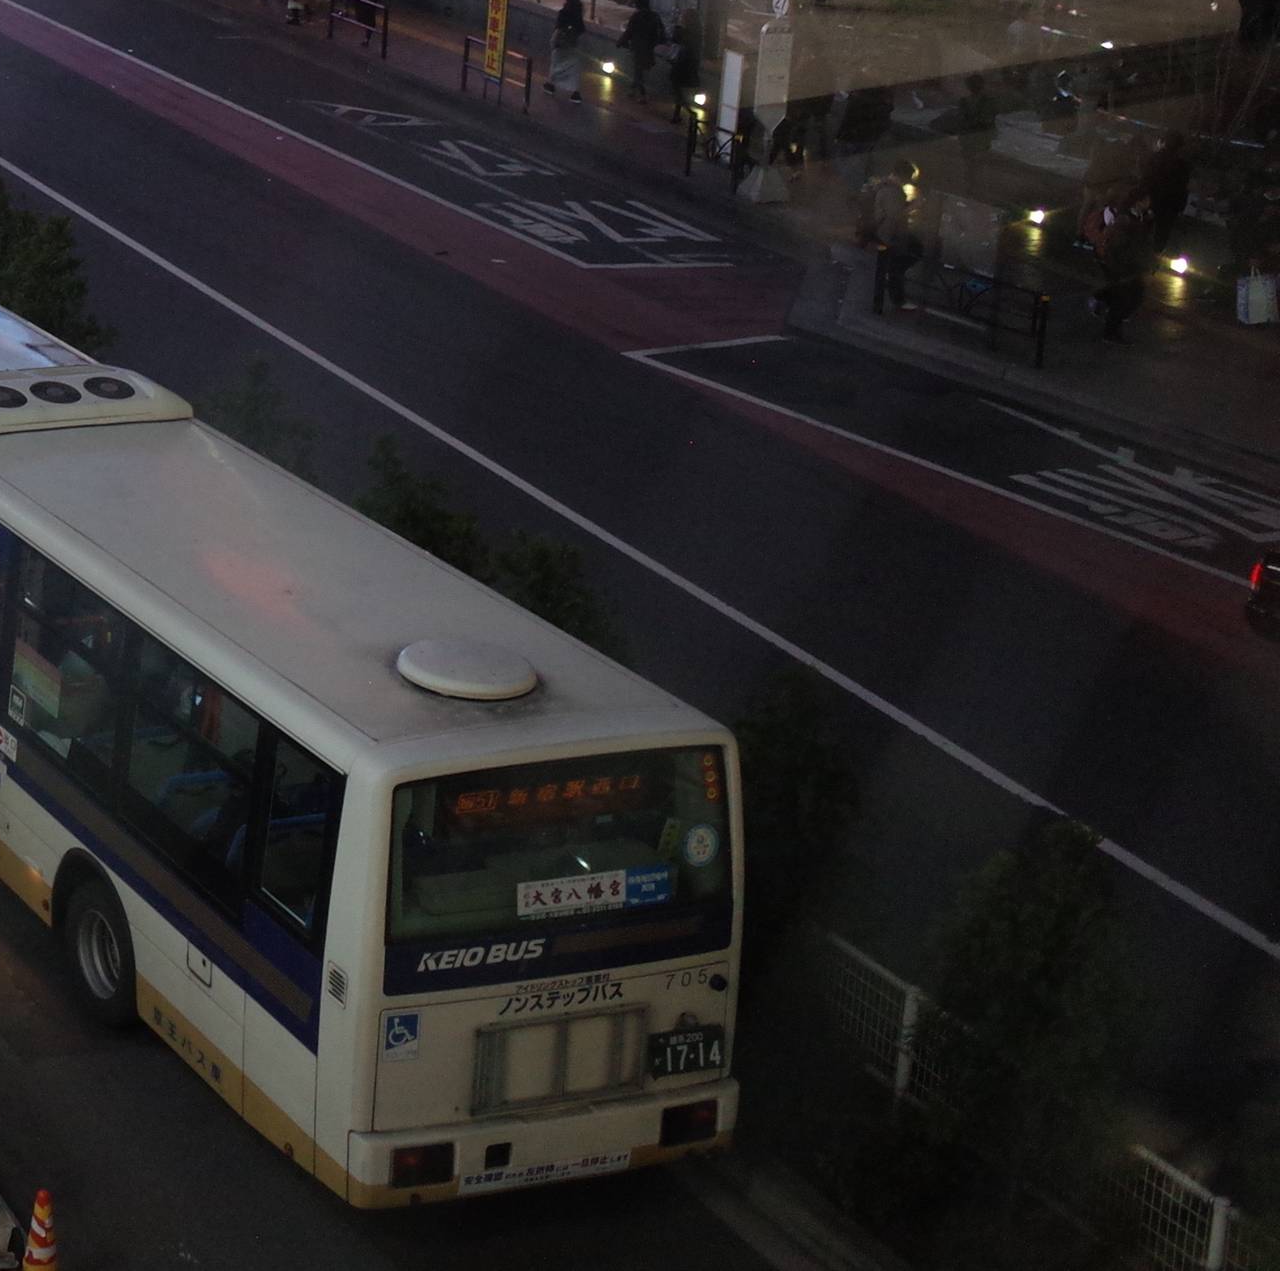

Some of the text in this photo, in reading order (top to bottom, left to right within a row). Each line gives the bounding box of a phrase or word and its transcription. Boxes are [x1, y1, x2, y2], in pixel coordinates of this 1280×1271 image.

[532, 879, 623, 906] 大宮八幡宮
[417, 938, 546, 973] KEIO BUS
[499, 982, 625, 1016] ノンステップバス
